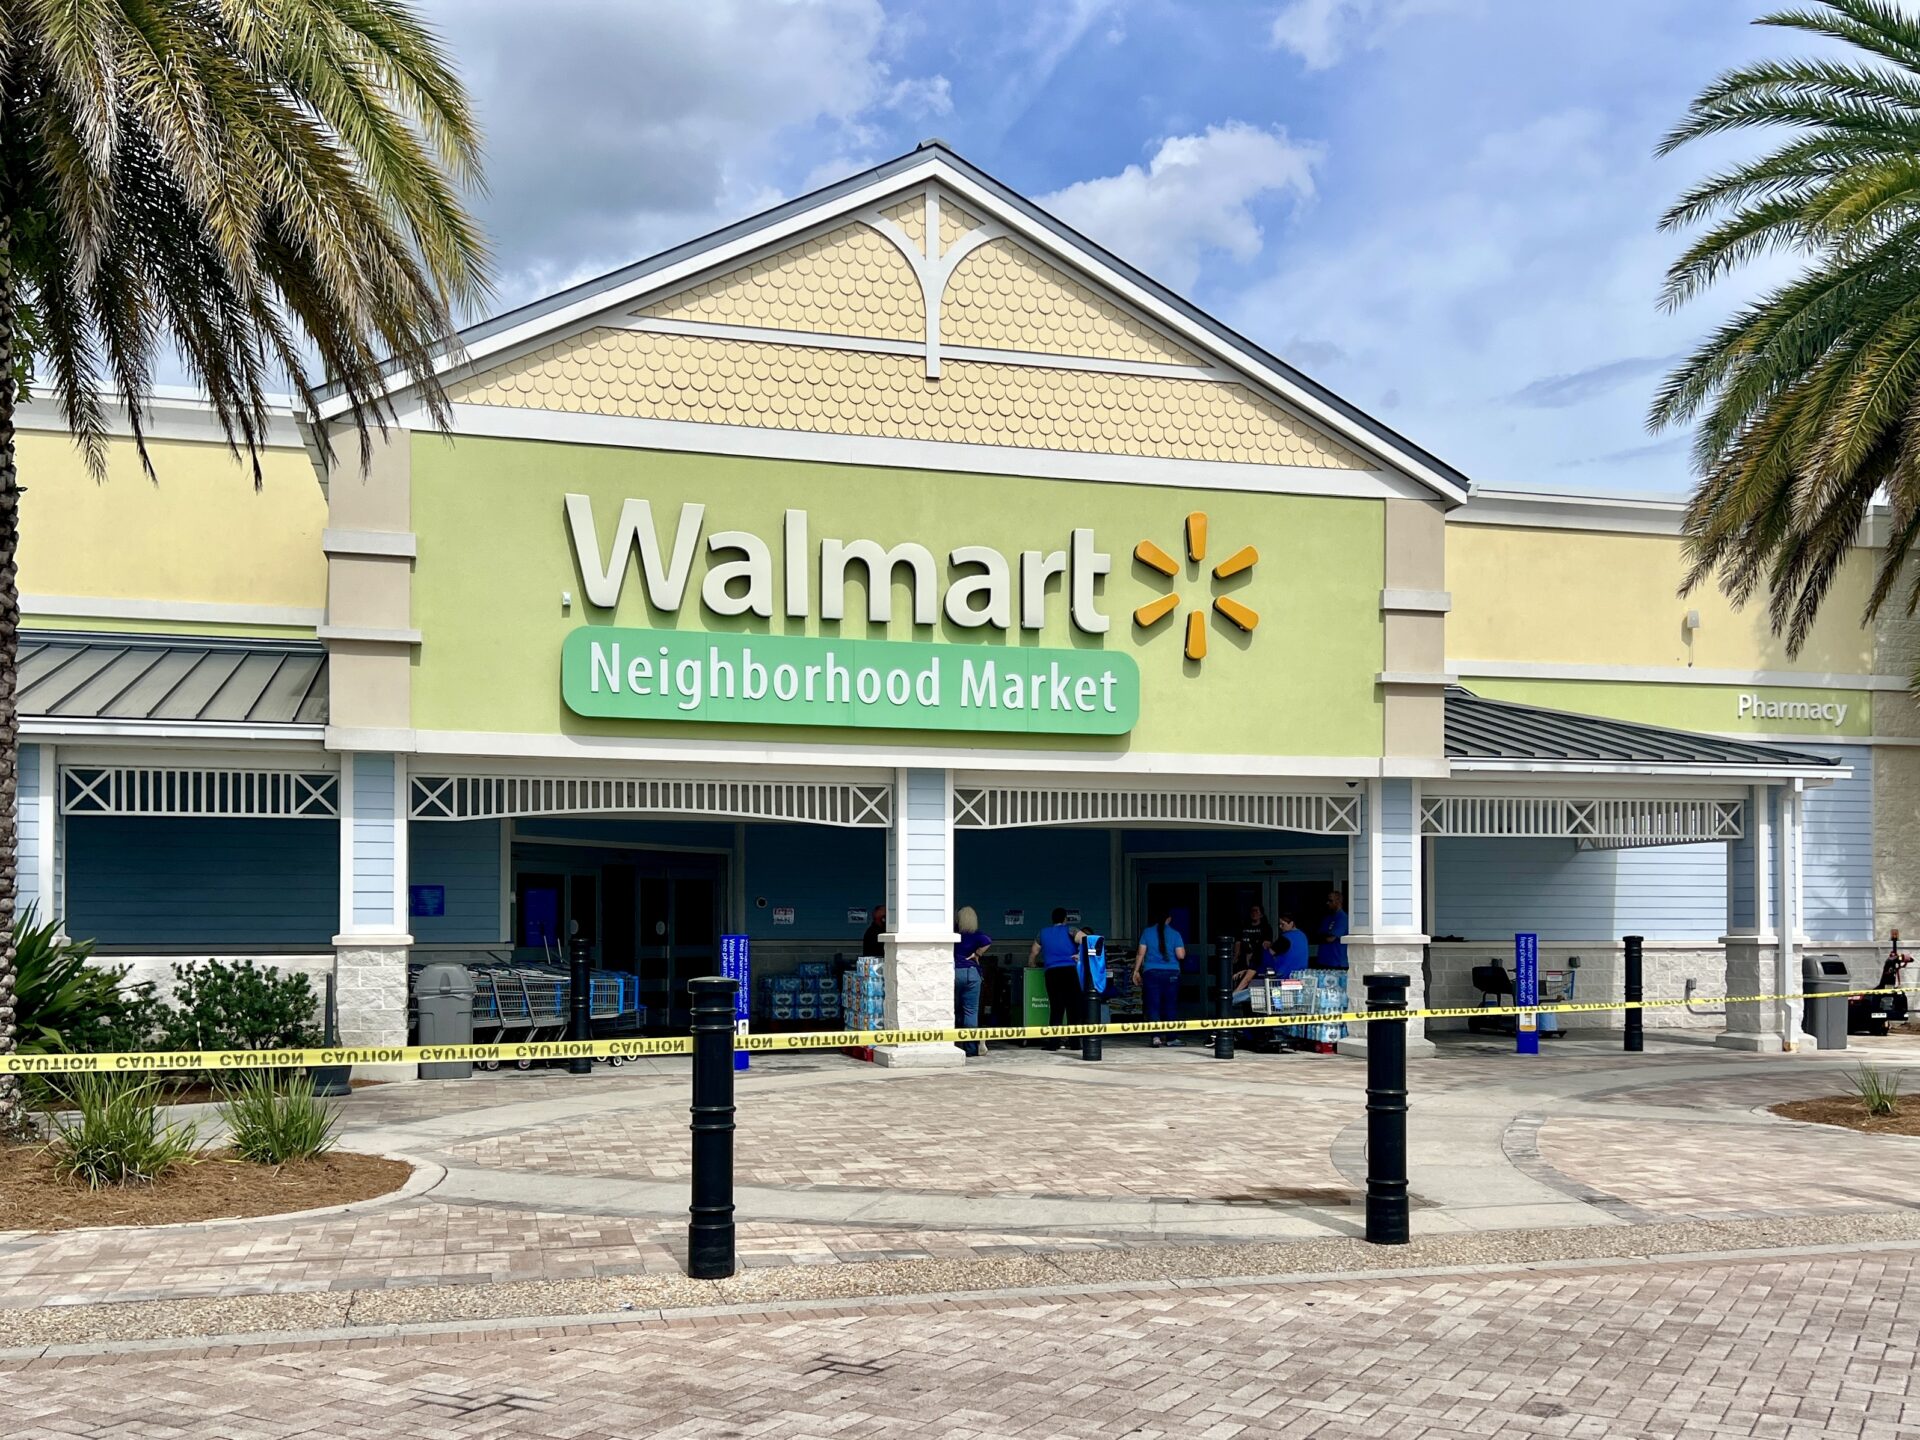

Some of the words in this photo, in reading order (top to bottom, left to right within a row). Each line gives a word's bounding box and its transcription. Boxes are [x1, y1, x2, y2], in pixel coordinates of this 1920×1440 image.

[564, 493, 1111, 634] Walmart
[589, 641, 942, 711] Neighborhood
[960, 659, 1119, 714] Market
[1738, 693, 1848, 727] Pharmacy
